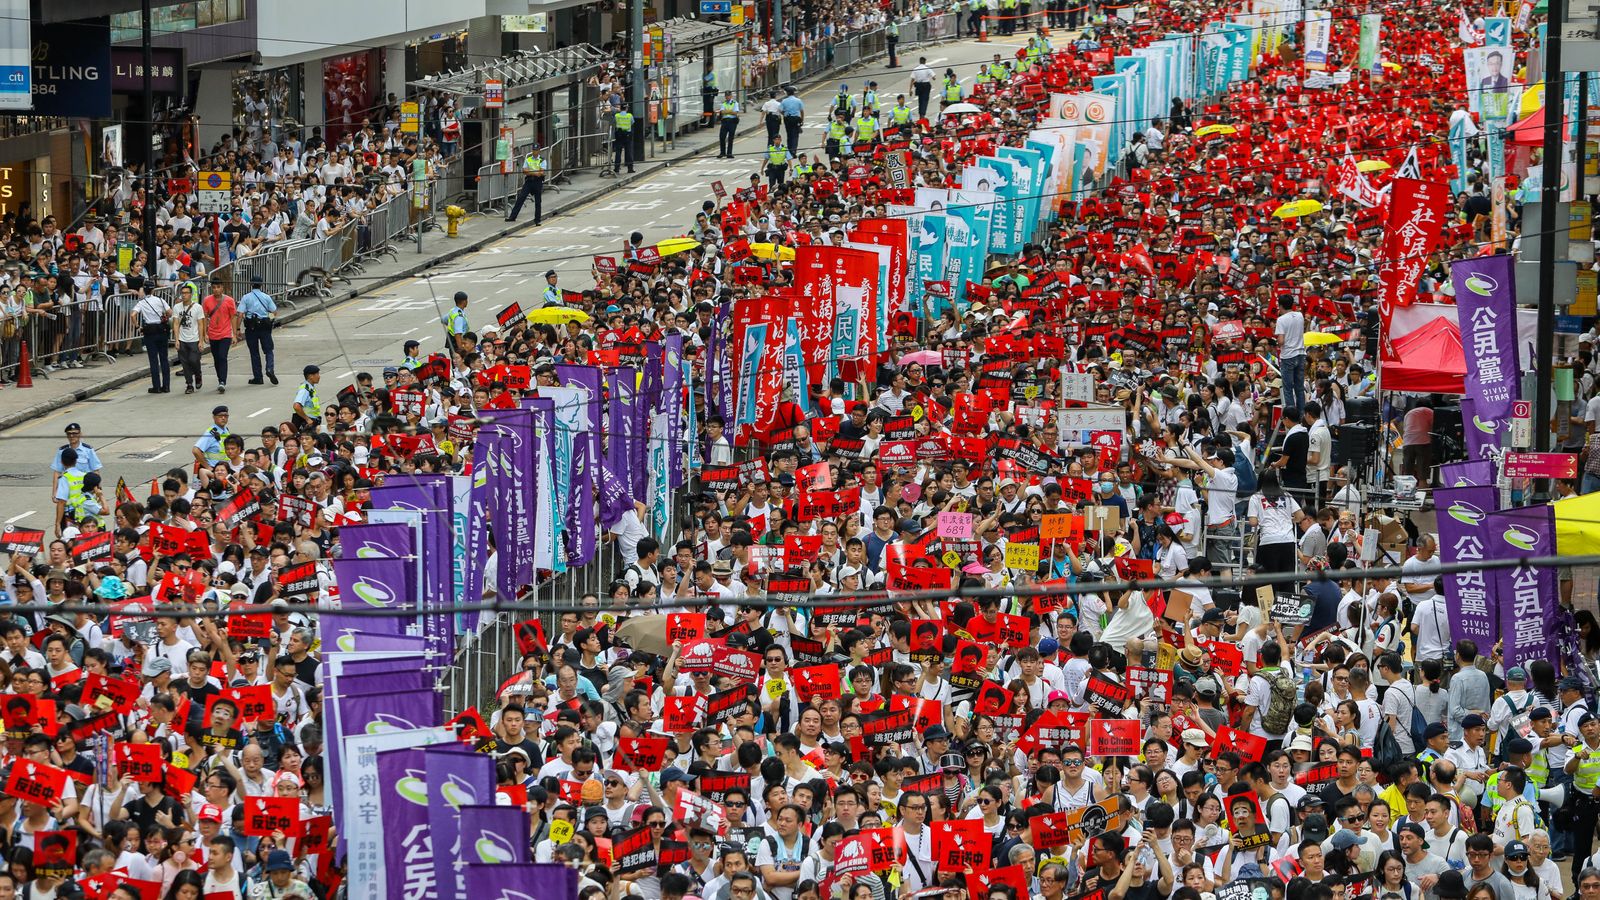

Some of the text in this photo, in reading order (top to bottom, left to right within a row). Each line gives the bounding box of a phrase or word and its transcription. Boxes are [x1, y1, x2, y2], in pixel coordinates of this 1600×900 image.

[9, 71, 24, 82] citi
[218, 204, 230, 212] 12
[992, 196, 1007, 249] 民主黨
[532, 225, 620, 235] BUS
[941, 515, 971, 525] 引渡貪官
[945, 525, 965, 535] 689
[670, 627, 697, 640] 反送中
[911, 653, 940, 662] 林鄭下台
[951, 675, 981, 688] 林鄭下台
[800, 683, 832, 693] No China
[873, 730, 913, 744] 逃犯條例
[1098, 736, 1133, 745] No China
[1098, 745, 1133, 754] Extradition
[1219, 743, 1230, 752] No
[120, 762, 153, 776] 反送中
[15, 777, 55, 799] 反送中
[252, 815, 291, 831] 反送中
[948, 851, 983, 866] 反送中
